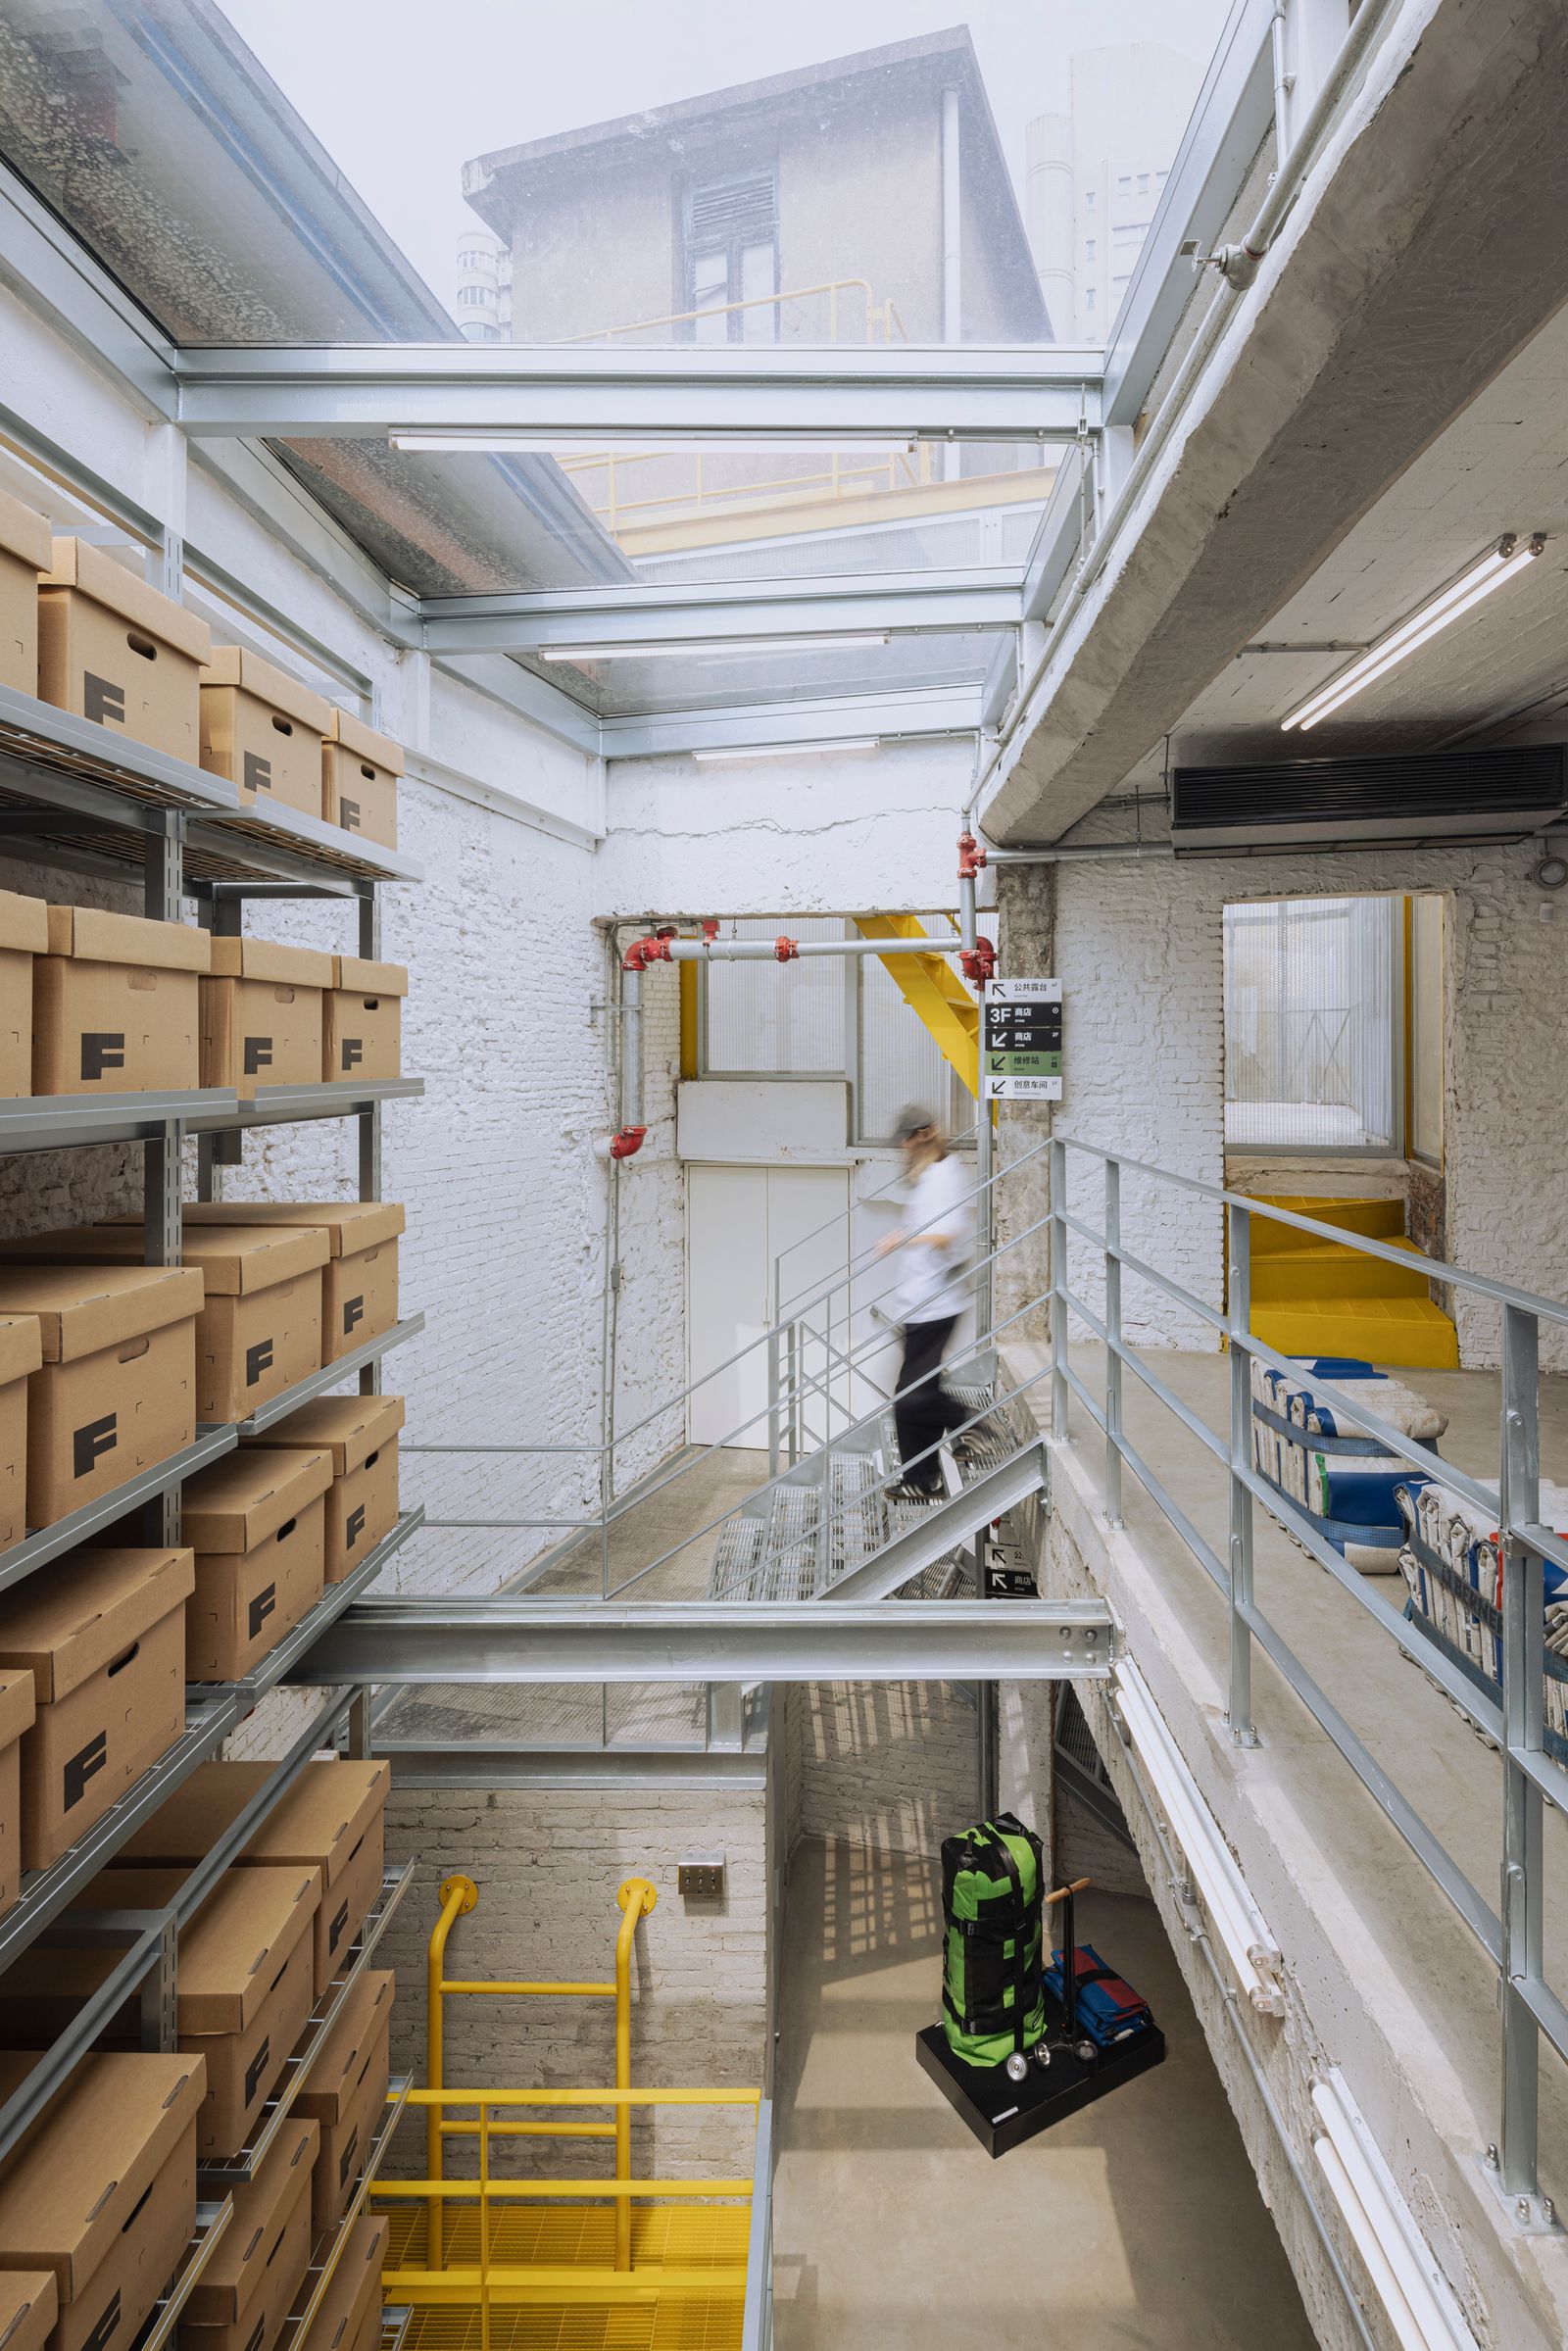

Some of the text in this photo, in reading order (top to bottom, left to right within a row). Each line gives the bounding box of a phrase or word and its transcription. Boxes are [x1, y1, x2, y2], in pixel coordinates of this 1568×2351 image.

[84, 670, 124, 725] F
[244, 751, 270, 792] F
[340, 797, 360, 831] F
[1014, 983, 1048, 992] 公共露台
[990, 1008, 1011, 1023] 3F
[1014, 1007, 1032, 1017] 商店
[81, 1033, 124, 1080] F
[244, 1037, 272, 1074] F
[342, 1039, 362, 1070] F
[1014, 1032, 1032, 1042] 商店
[1013, 1056, 1040, 1065] 维修站
[1014, 1080, 1048, 1090] 创意车间
[344, 1296, 363, 1335] F
[247, 1339, 272, 1387] F
[74, 1412, 117, 1479] F
[347, 1504, 365, 1550] F
[1013, 1550, 1025, 1560] 公
[1014, 1576, 1031, 1586] 商店
[249, 1583, 275, 1641] F
[64, 1730, 106, 1813] F
[329, 1898, 348, 1956] F
[245, 2035, 269, 2110] F
[340, 2125, 357, 2190] F
